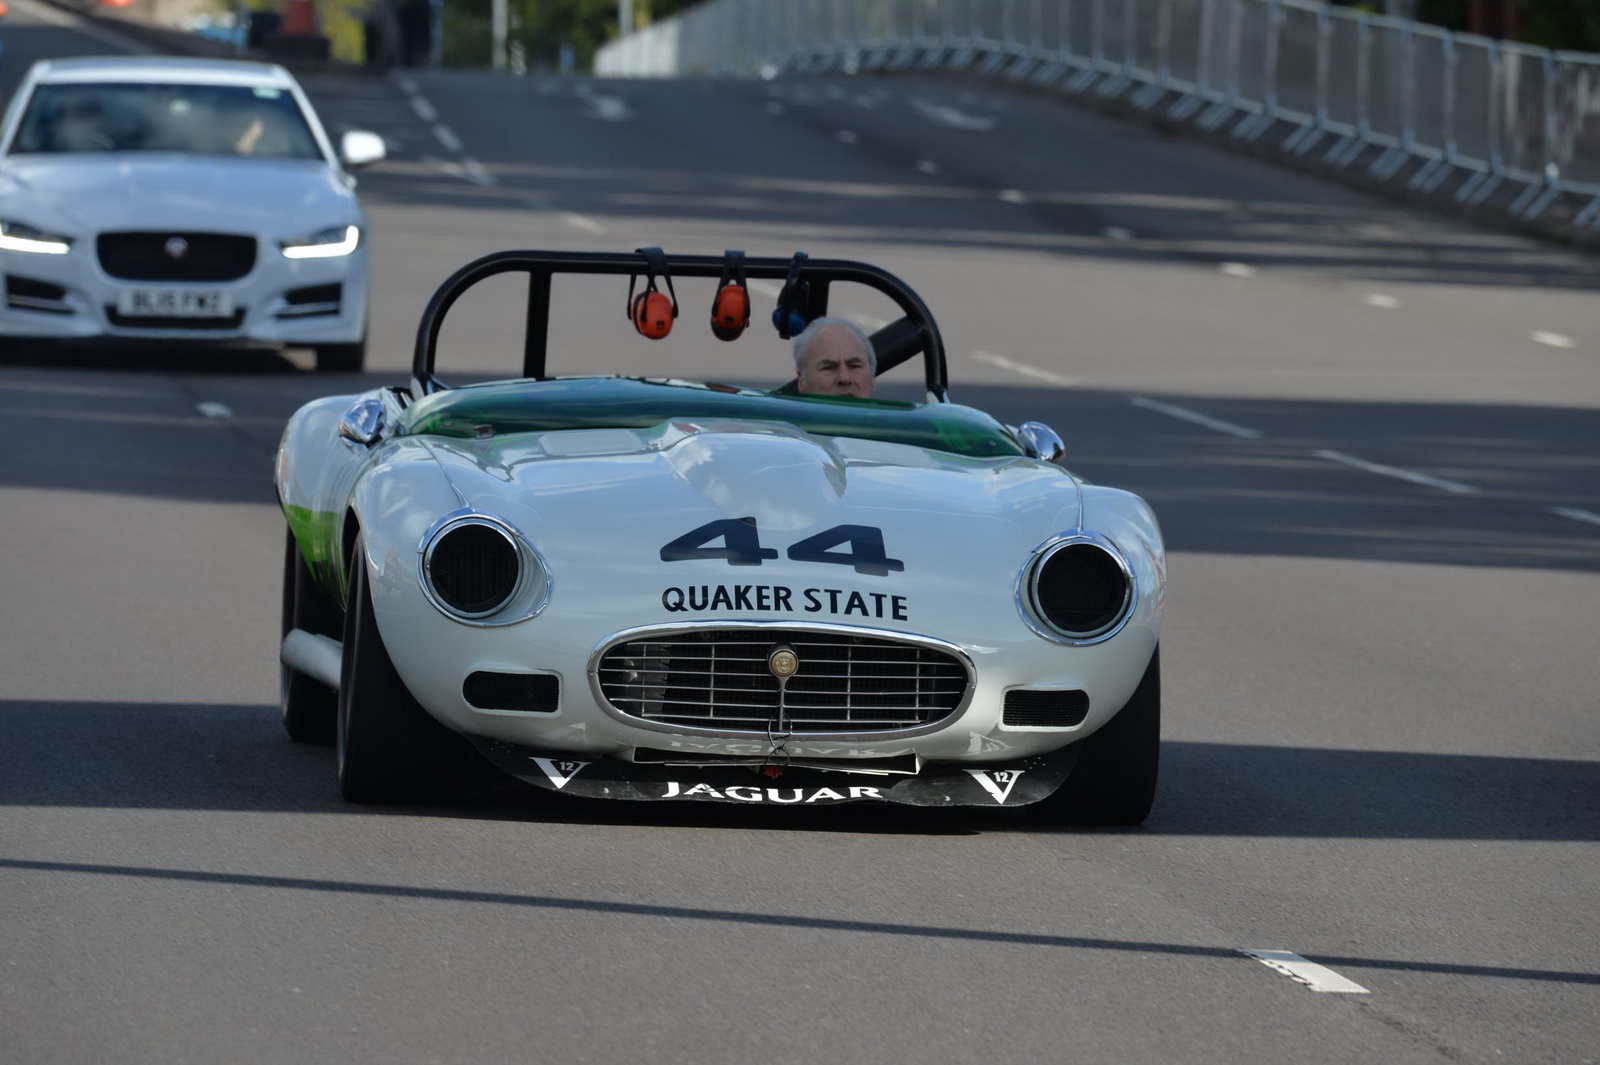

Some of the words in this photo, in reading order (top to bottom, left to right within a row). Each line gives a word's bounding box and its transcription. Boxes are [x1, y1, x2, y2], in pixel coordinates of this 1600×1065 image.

[660, 516, 905, 577] 44
[661, 584, 794, 612] QUAKER
[803, 588, 908, 622] STATE
[661, 781, 884, 803] JAGUAR
